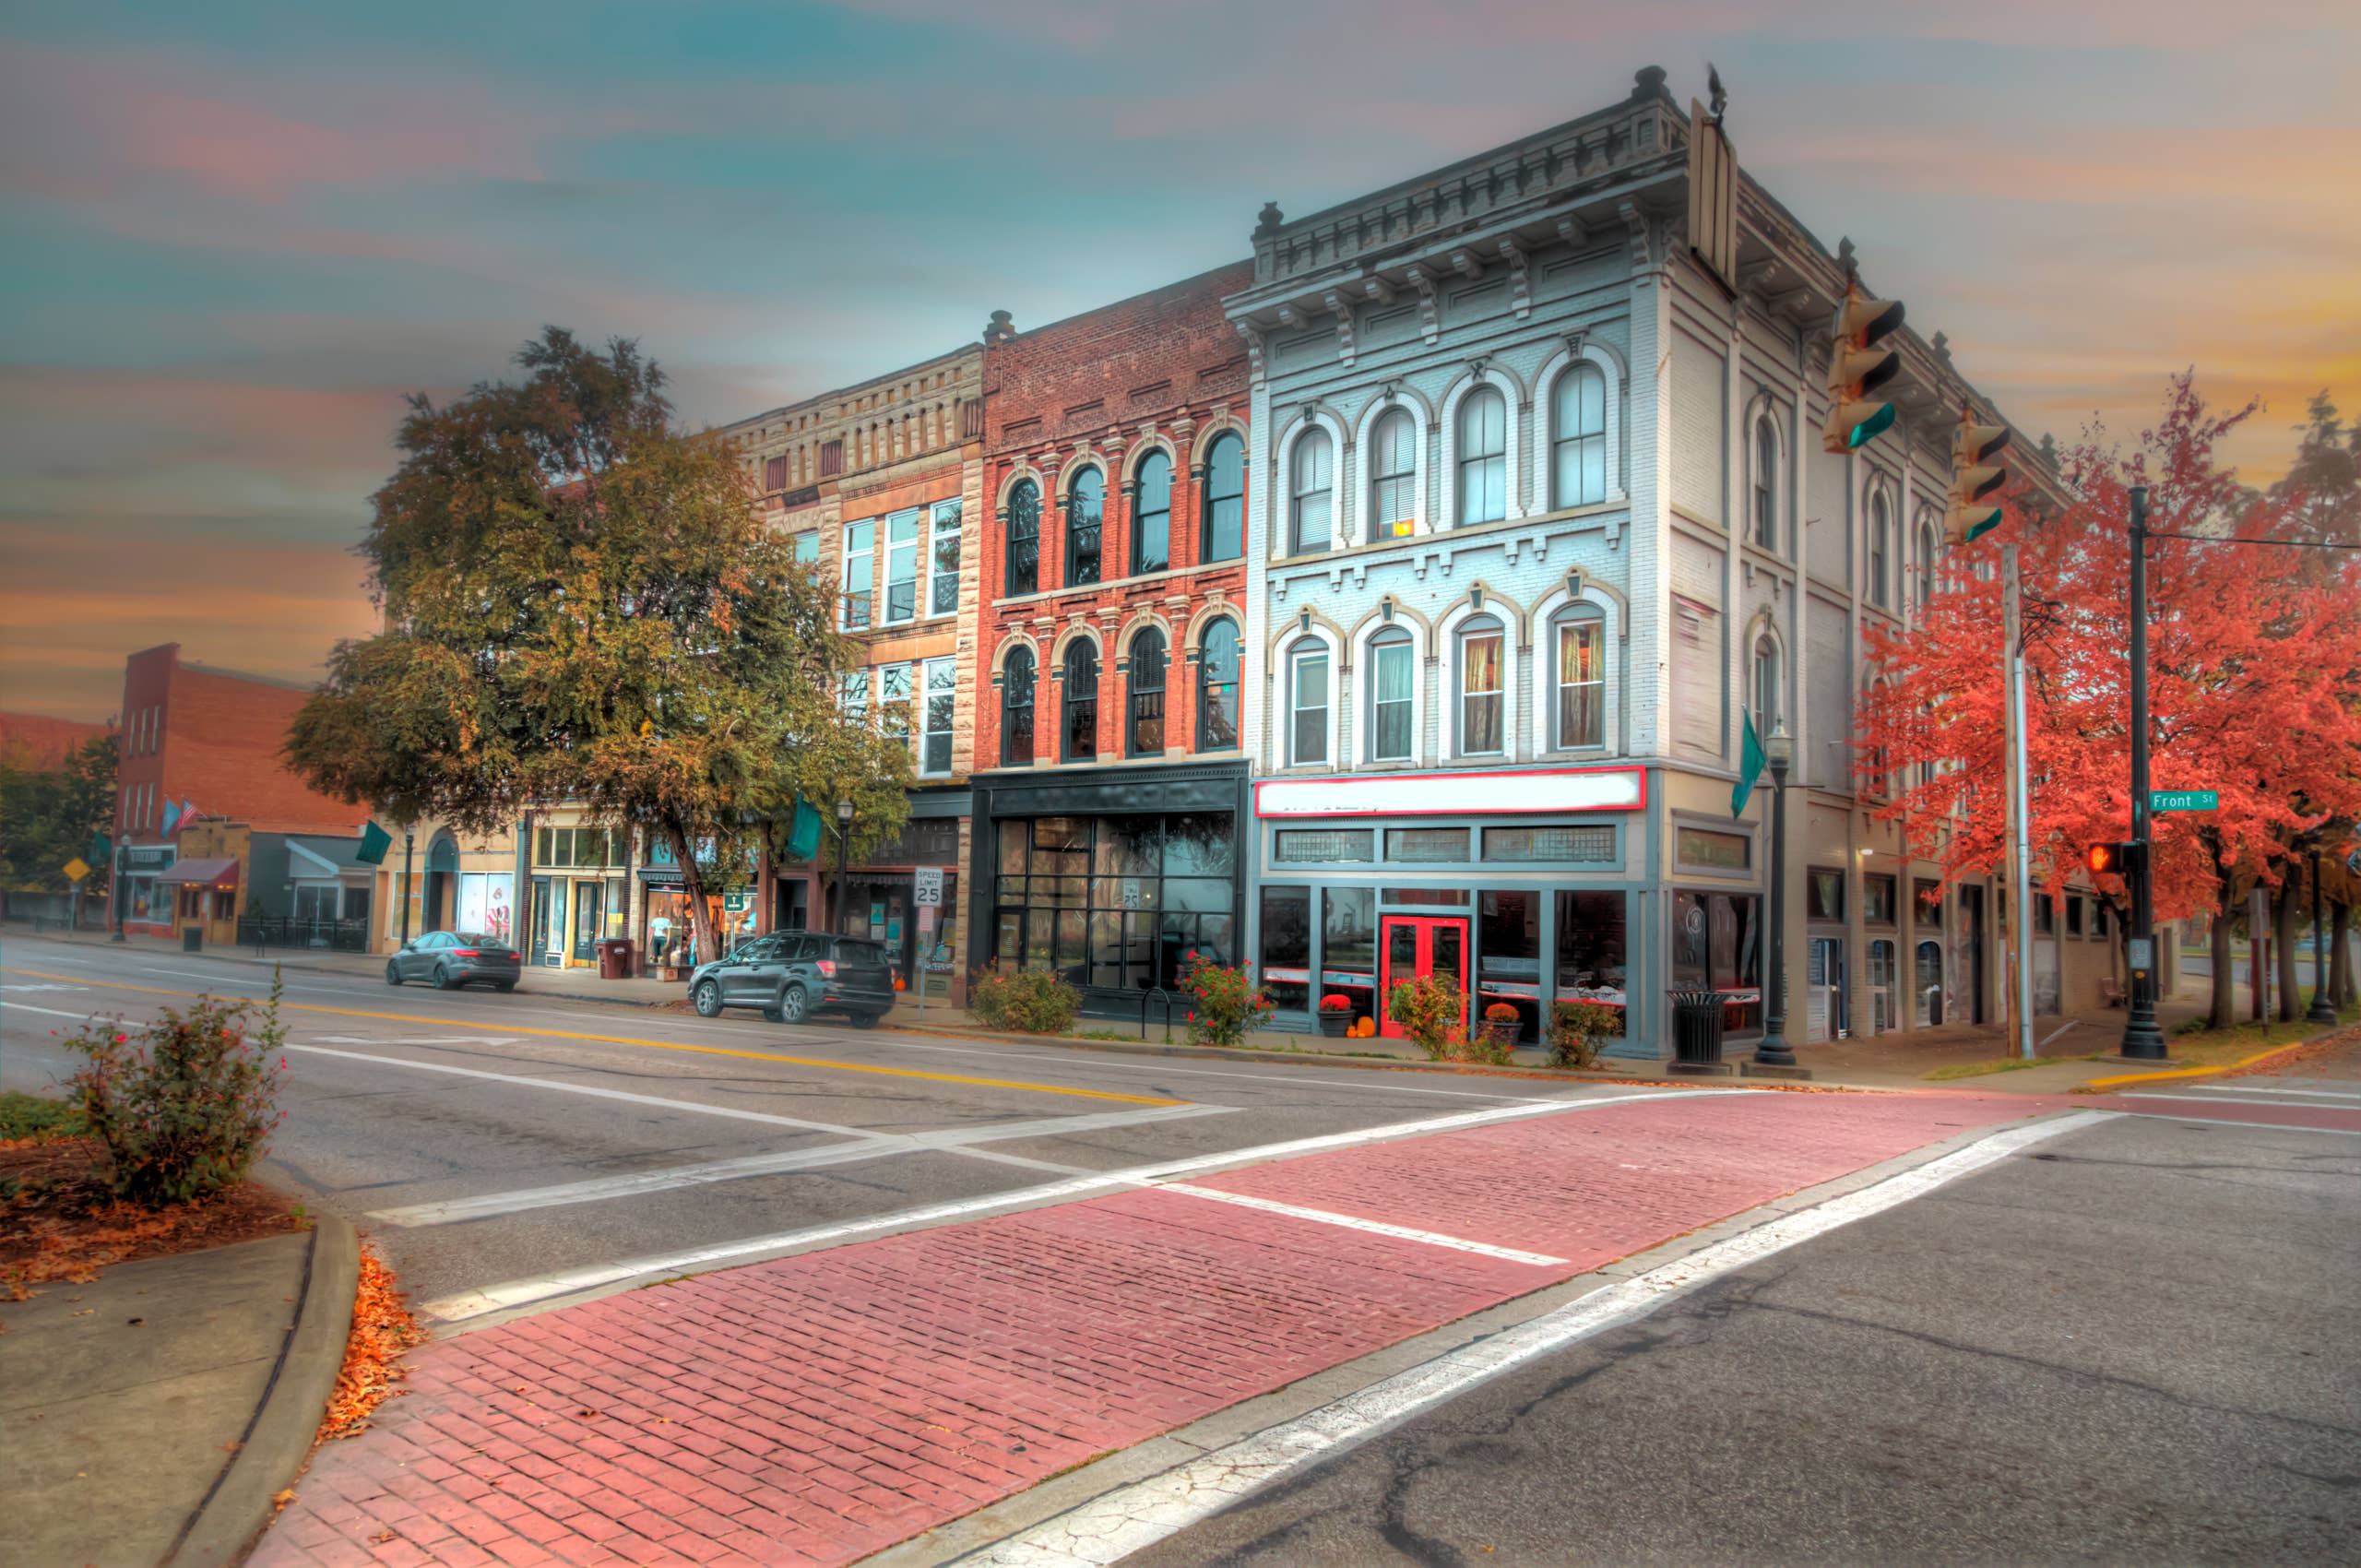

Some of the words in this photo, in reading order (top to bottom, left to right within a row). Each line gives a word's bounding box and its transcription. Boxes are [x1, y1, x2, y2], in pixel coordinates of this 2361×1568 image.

[2153, 795, 2191, 807] Front
[918, 871, 941, 879] SPEED
[918, 887, 939, 902] 25
